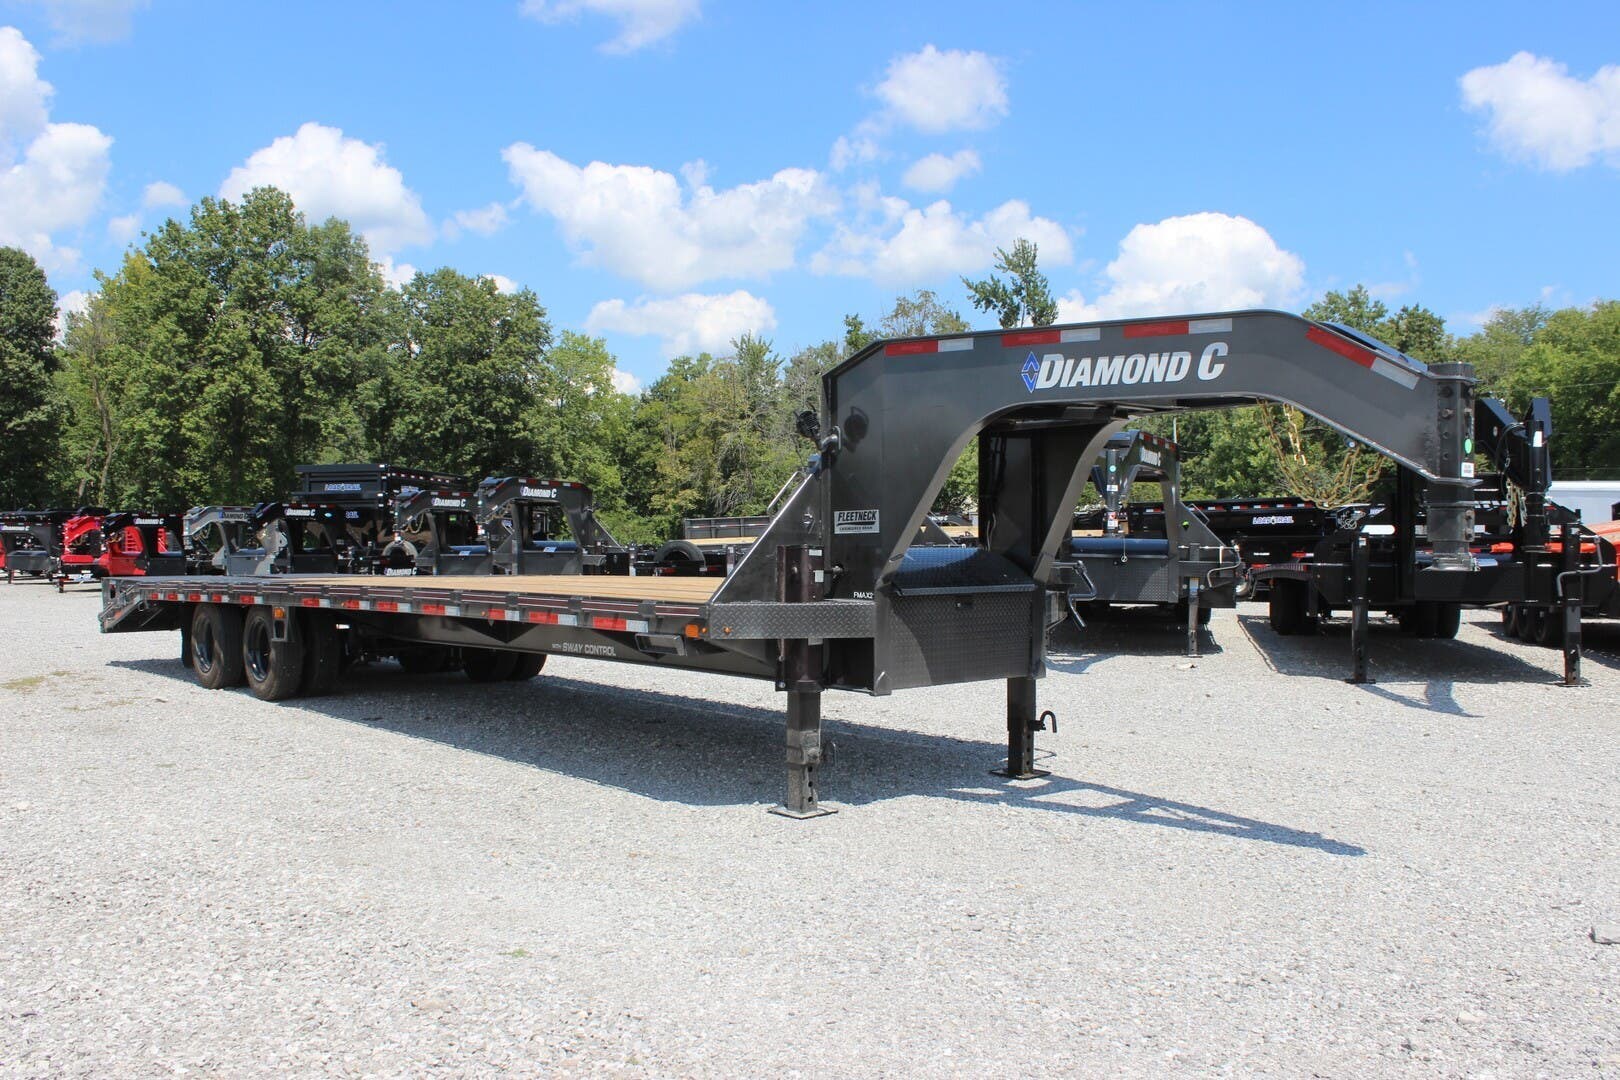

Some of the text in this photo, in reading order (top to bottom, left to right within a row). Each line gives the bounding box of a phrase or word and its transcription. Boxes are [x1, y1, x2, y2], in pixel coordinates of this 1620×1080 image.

[1035, 341, 1229, 390] DIAMOND C
[522, 486, 557, 498] DIAMOND C
[460, 498, 466, 507] C
[837, 511, 877, 522] FLEETNECK
[562, 642, 583, 654] SWAY
[584, 644, 617, 656] CONTROL
